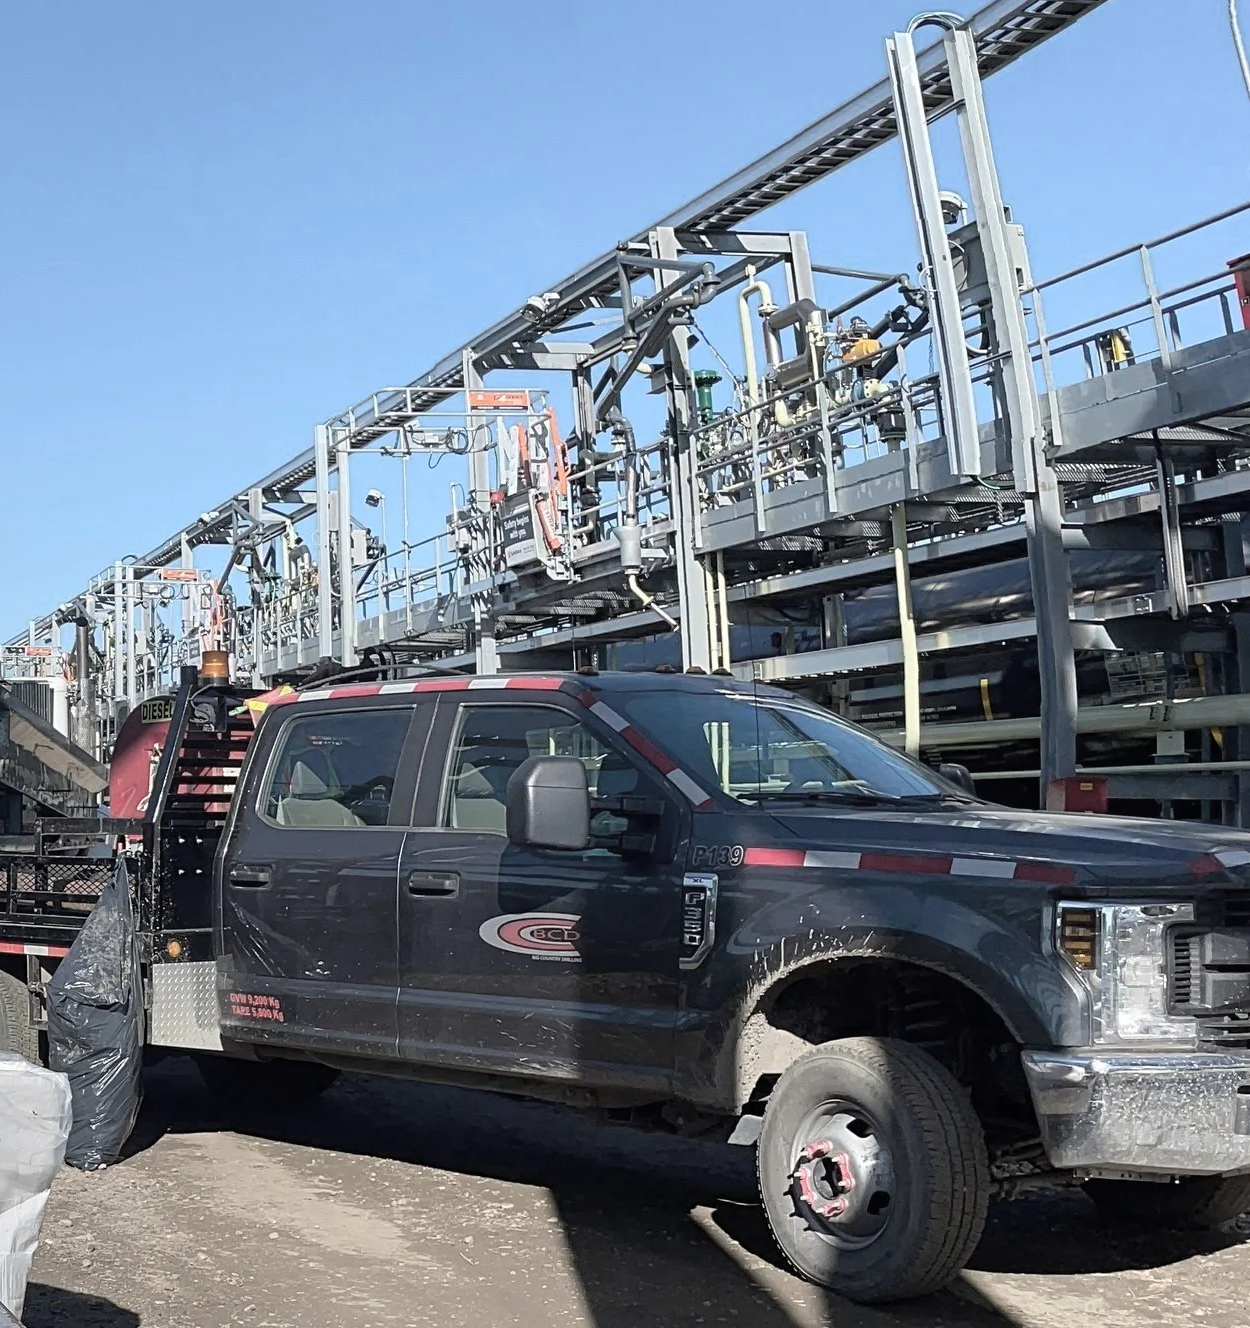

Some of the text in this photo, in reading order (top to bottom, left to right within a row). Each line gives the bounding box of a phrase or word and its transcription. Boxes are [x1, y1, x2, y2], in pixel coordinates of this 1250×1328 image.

[692, 845, 744, 867] P139
[683, 892, 706, 946] F350
[533, 929, 581, 941] BCD
